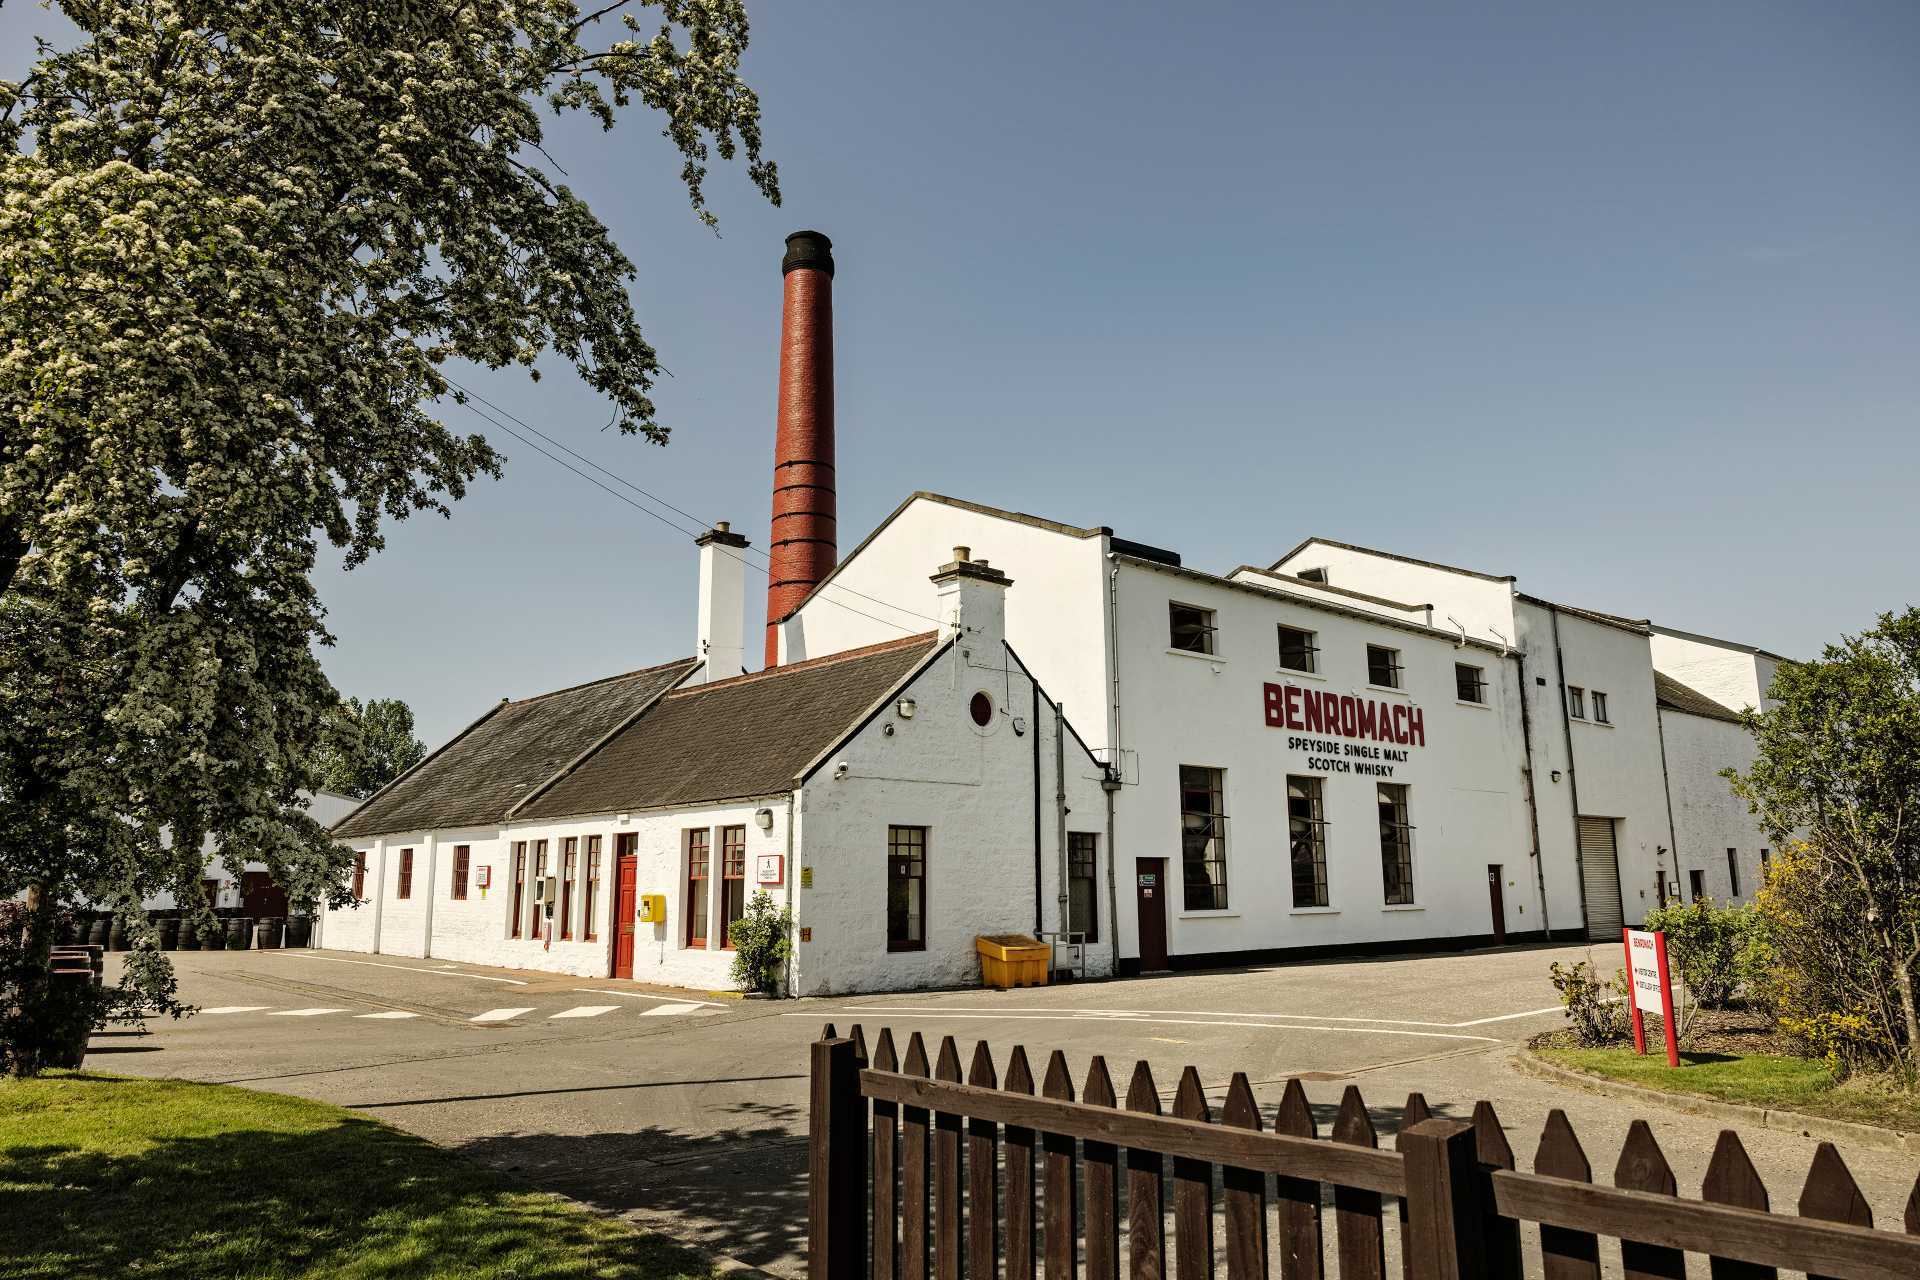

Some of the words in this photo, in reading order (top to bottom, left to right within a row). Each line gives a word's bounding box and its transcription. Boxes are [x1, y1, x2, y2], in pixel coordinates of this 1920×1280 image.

[1264, 682, 1425, 747] BENROMACH
[1288, 737, 1340, 755] SPEYSIDE
[1344, 744, 1380, 759] SINGLE
[1384, 749, 1409, 762] MALT
[1308, 757, 1350, 773] SCOTCH
[1354, 762, 1394, 777] WHISKY
